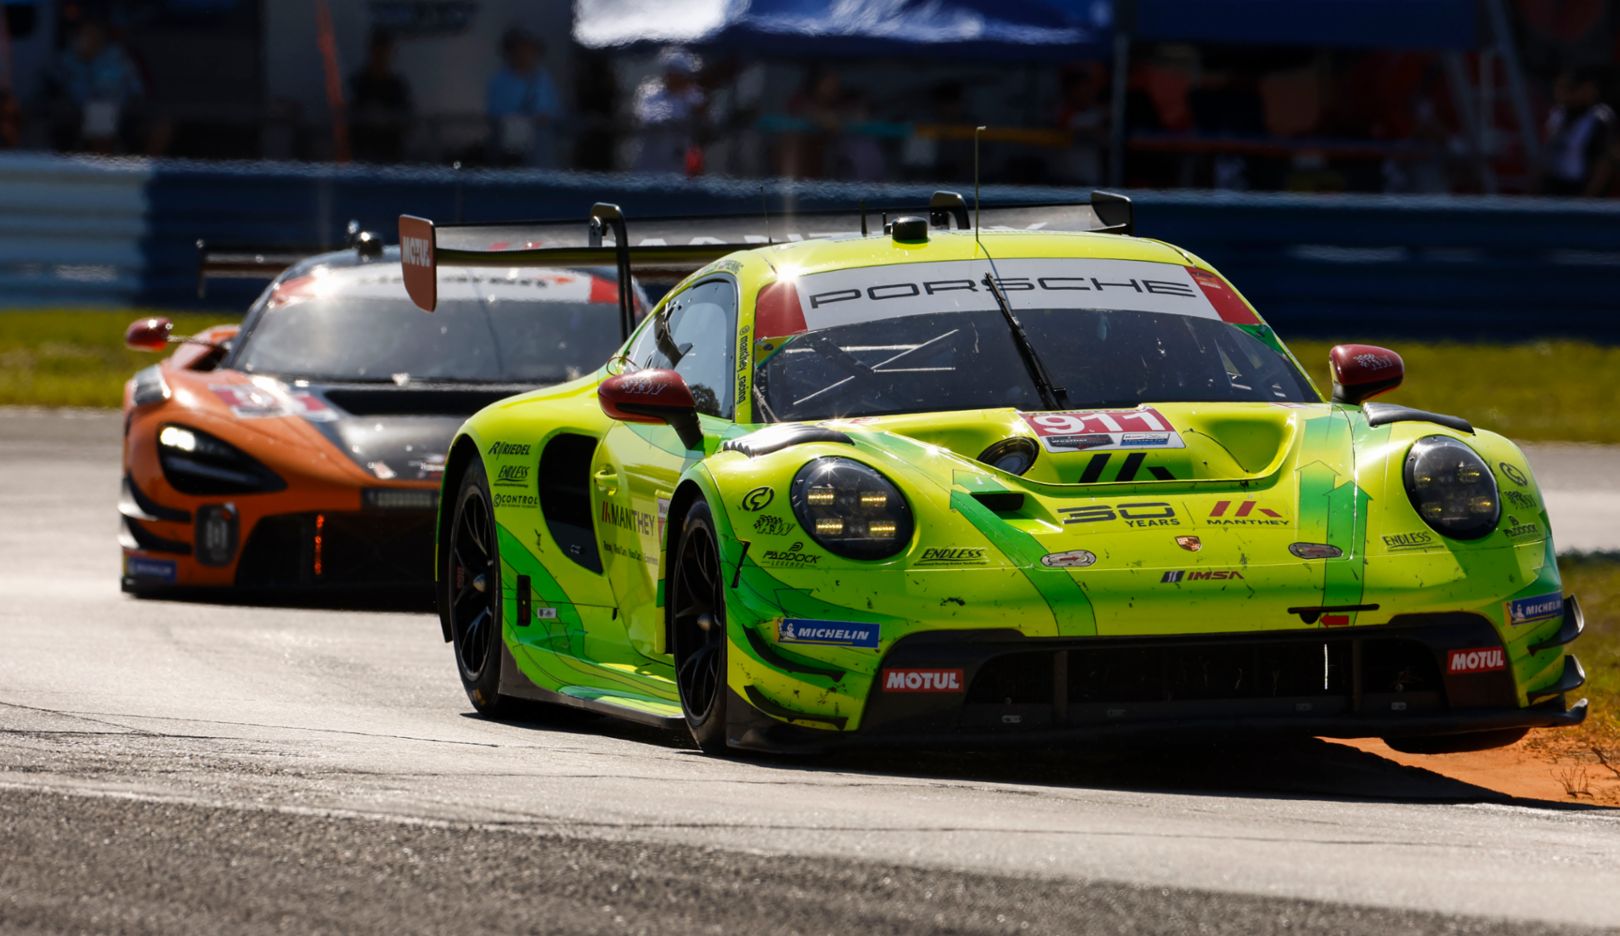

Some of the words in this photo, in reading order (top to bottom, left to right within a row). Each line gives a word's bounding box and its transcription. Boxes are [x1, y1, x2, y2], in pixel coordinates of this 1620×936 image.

[403, 236, 429, 267] MOTUL
[810, 277, 1197, 309] PORSCHE
[1034, 411, 1166, 433] 911
[502, 494, 538, 505] CONTROL
[611, 503, 655, 537] MANTHEY
[1057, 502, 1176, 525] 30
[1125, 518, 1181, 528] YEARS
[1382, 531, 1432, 546] ENDLESS
[763, 550, 821, 564] PADDOCK
[921, 547, 985, 559] ENDLESS
[1187, 571, 1245, 581] IMSA
[798, 627, 870, 641] MICHELIN
[1451, 650, 1504, 671] MOTUL
[886, 671, 960, 690] MOTUL
